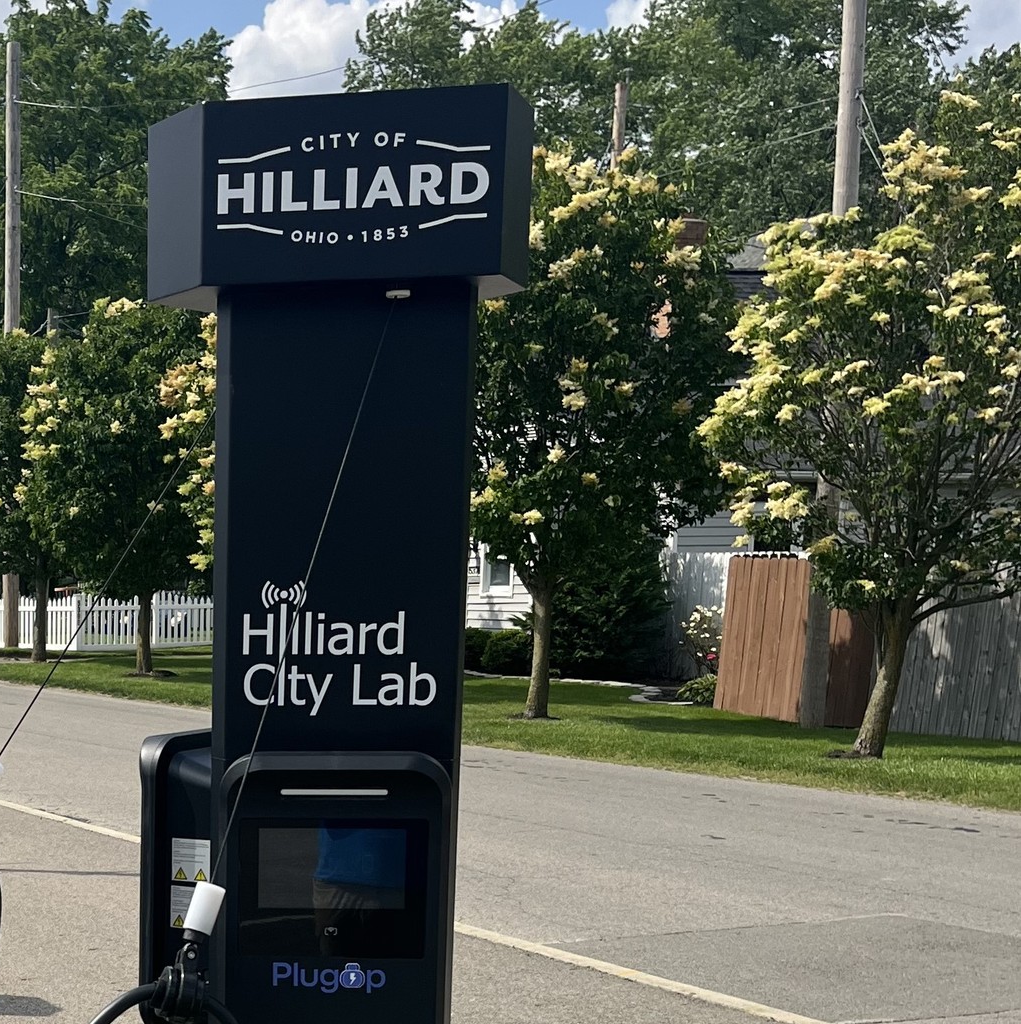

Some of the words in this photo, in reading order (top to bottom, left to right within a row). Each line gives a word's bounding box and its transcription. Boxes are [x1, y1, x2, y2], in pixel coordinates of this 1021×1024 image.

[301, 132, 360, 153] CITY
[374, 132, 406, 148] OF
[217, 161, 490, 215] HILLIARD
[290, 230, 338, 245] OHIO
[362, 225, 409, 243] 1853
[241, 604, 406, 656] Hilliard
[243, 657, 333, 716] City
[352, 662, 437, 706] Lab
